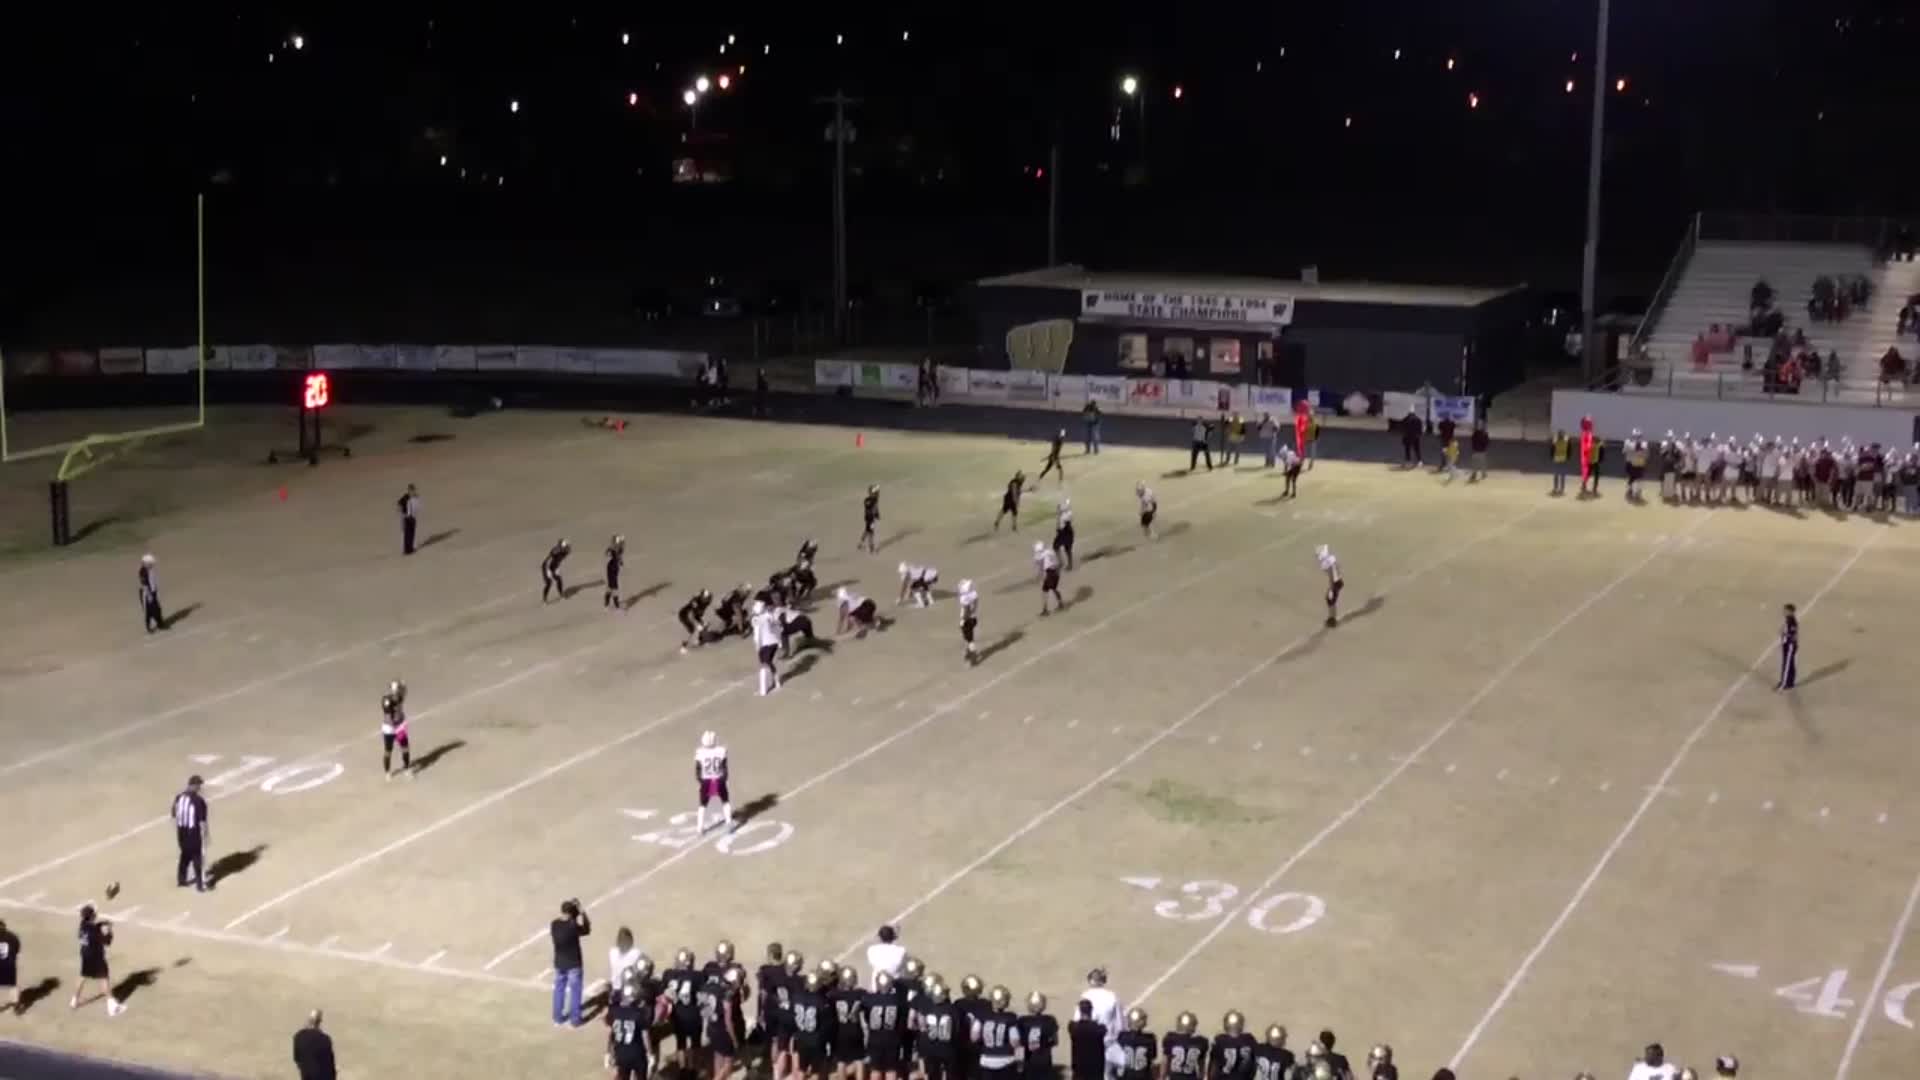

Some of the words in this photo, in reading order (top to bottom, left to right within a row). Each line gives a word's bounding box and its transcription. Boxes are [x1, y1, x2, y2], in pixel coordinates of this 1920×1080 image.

[1103, 292, 1136, 302] HOME
[1142, 294, 1155, 304] OF
[1163, 295, 1183, 305] THE
[1128, 303, 1163, 319] STATE
[1170, 305, 1248, 322] CHAMPIONS
[304, 373, 328, 409] 20
[1131, 382, 1161, 398] ACE
[704, 757, 724, 775] 20
[1153, 879, 1326, 934] 30
